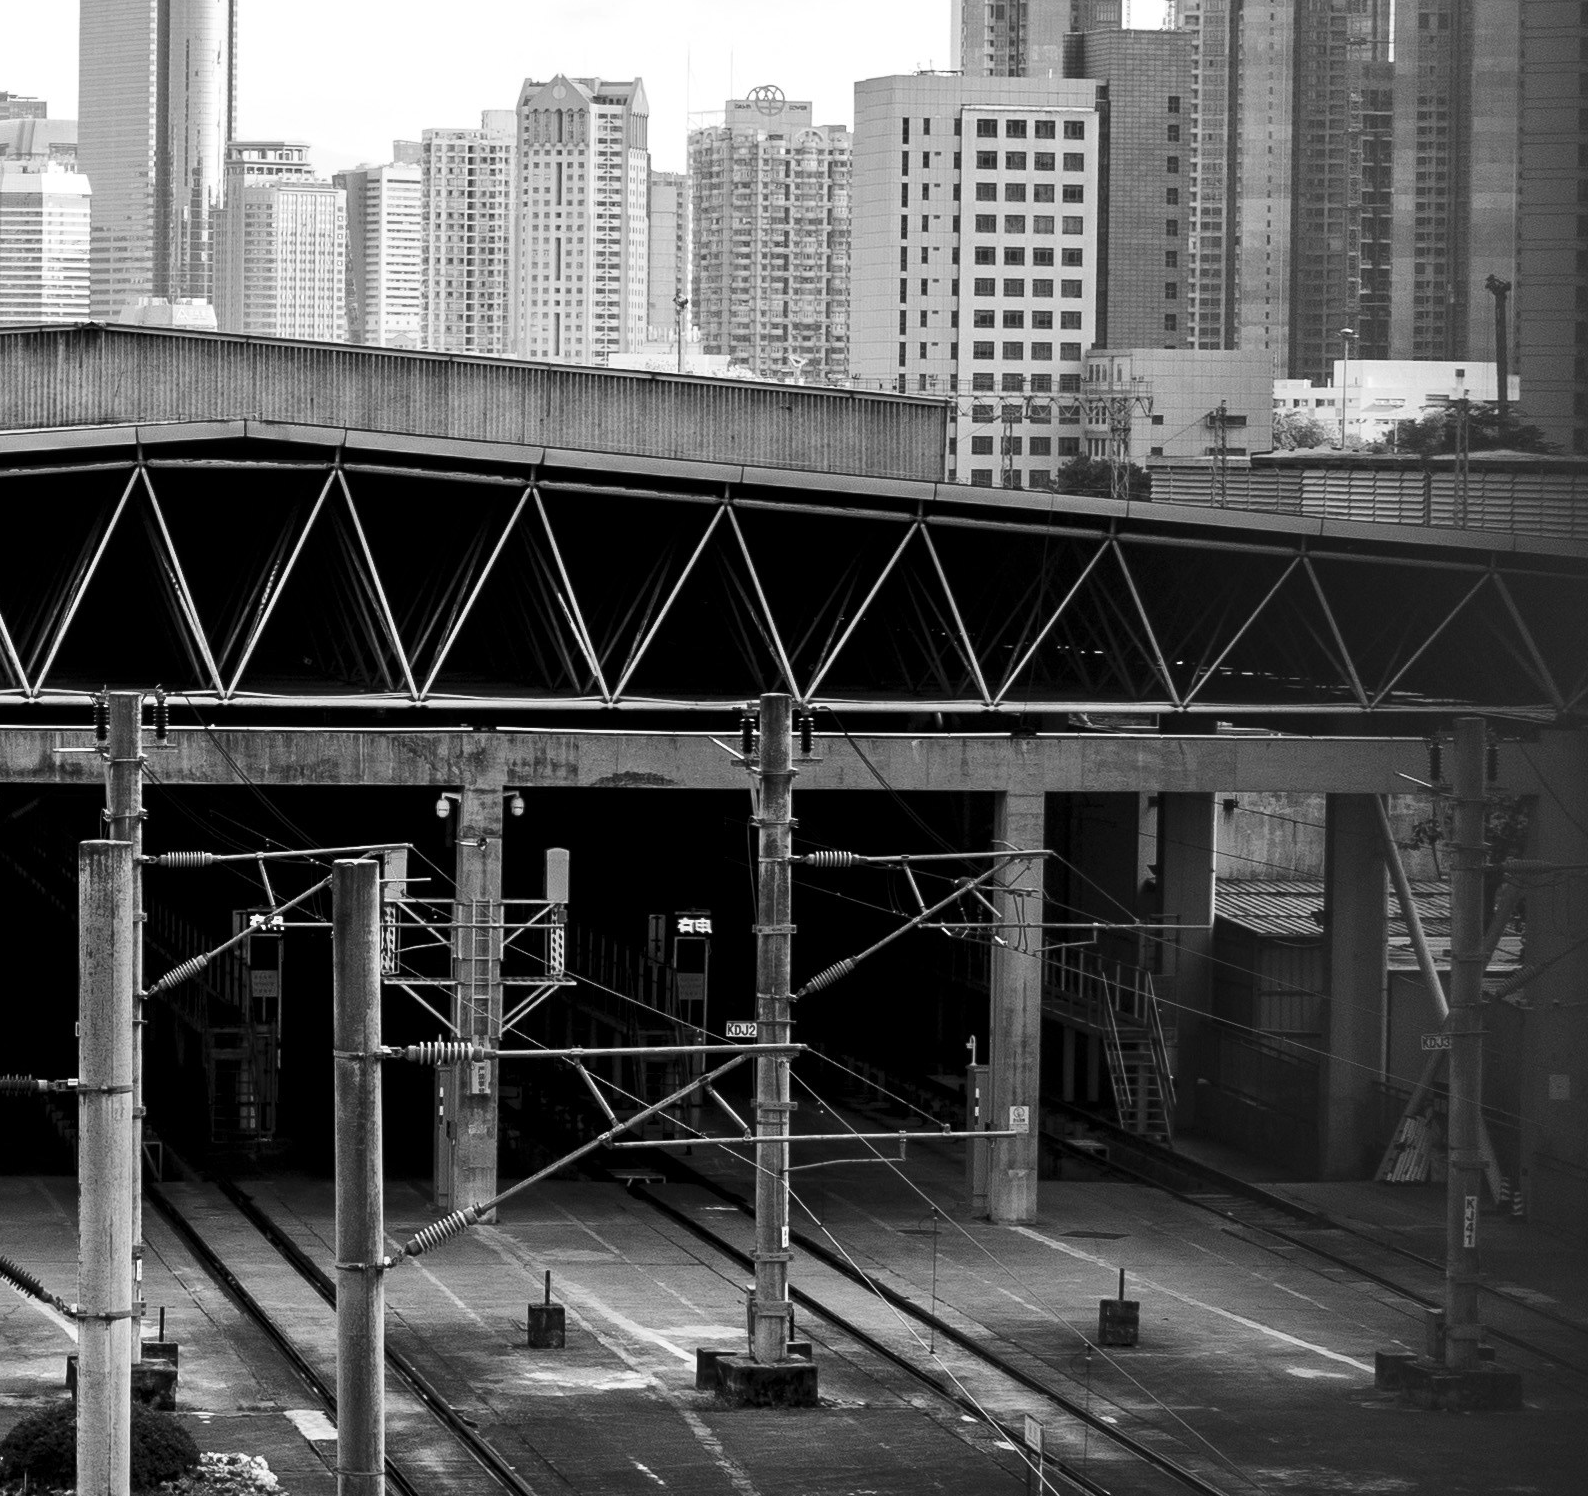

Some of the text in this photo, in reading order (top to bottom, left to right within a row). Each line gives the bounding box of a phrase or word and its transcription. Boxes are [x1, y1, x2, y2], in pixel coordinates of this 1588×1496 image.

[676, 916, 713, 934] 有电
[728, 1024, 756, 1036] KDJ2
[1423, 1035, 1450, 1048] KDJ3
[1466, 1198, 1475, 1246] KJ41
